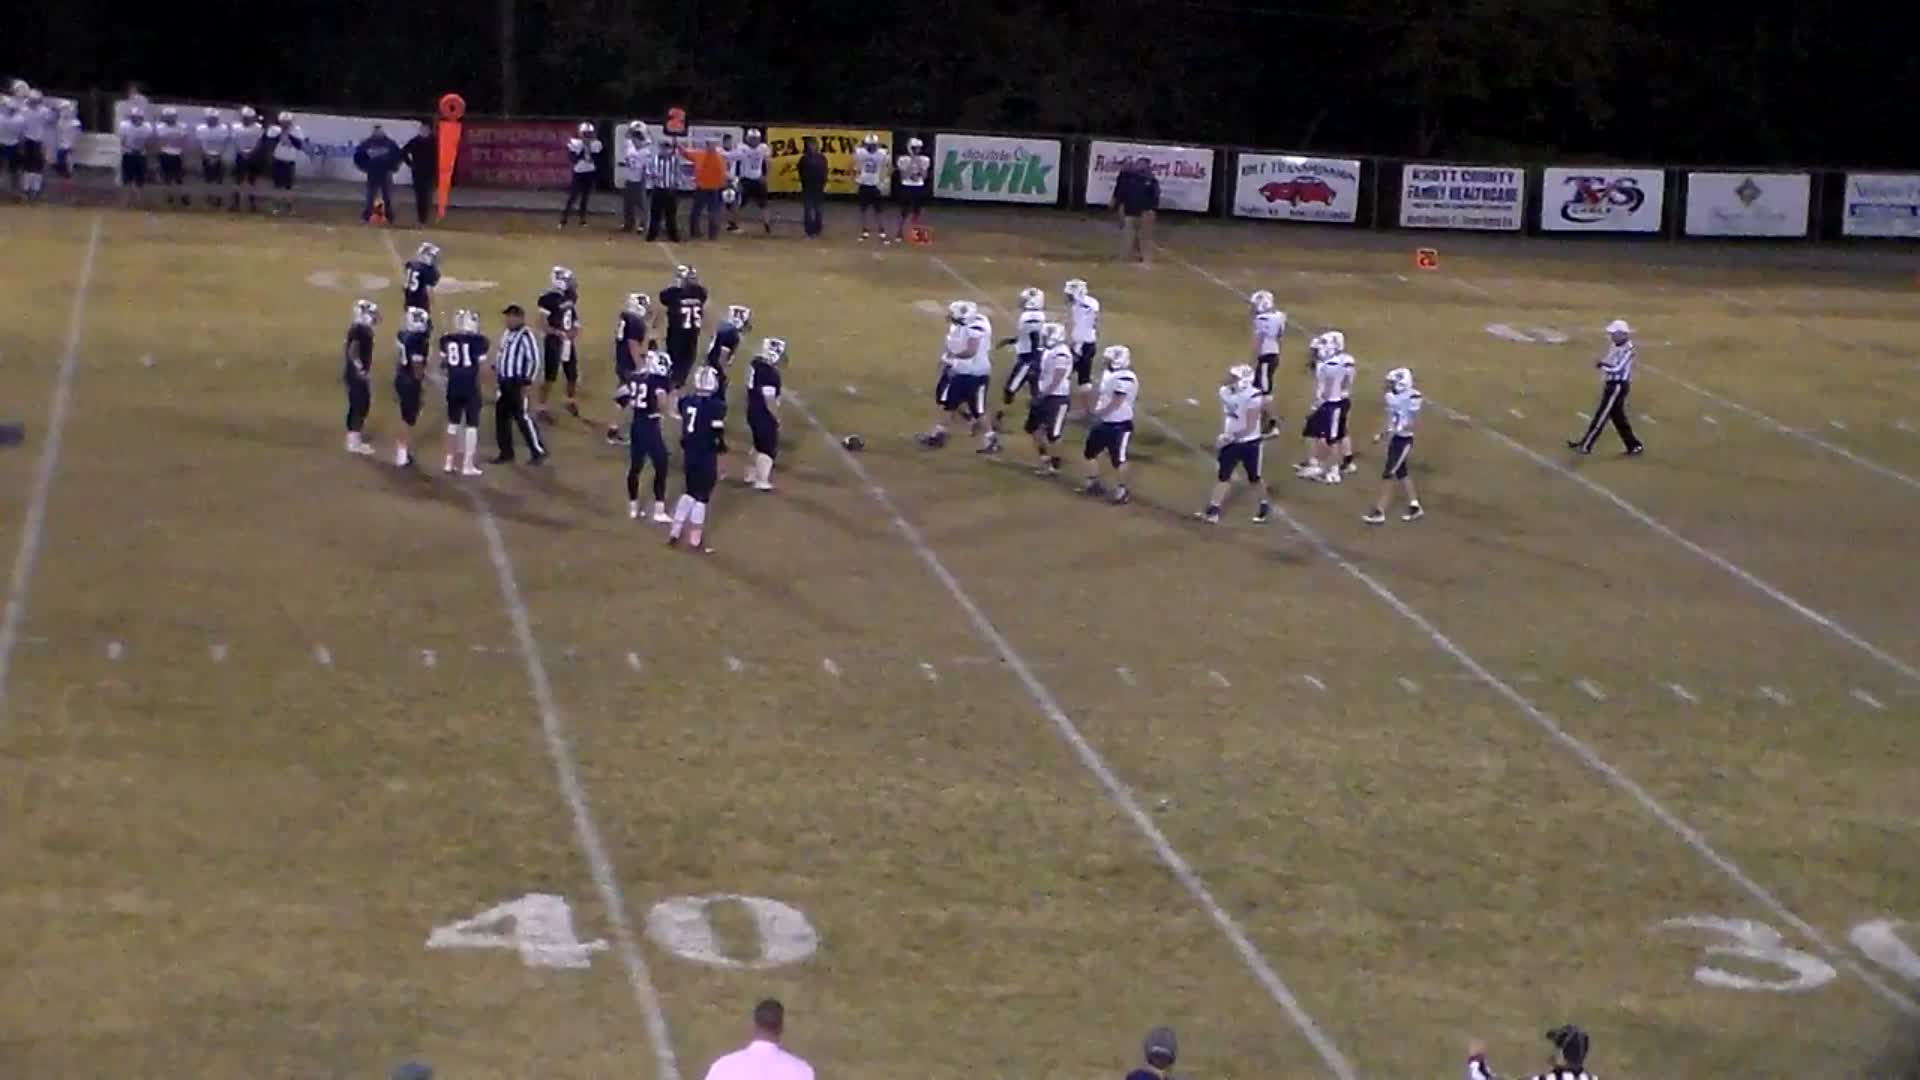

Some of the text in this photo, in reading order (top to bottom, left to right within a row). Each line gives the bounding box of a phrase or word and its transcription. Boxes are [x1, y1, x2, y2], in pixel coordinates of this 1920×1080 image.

[667, 107, 686, 133] 2
[938, 149, 1053, 194] kwik
[1461, 170, 1514, 184] COUNTY
[1449, 186, 1518, 202] HEALTHCARE
[681, 306, 702, 329] 75
[447, 341, 473, 367] 81
[686, 406, 698, 433] 7
[425, 893, 820, 970] 40
